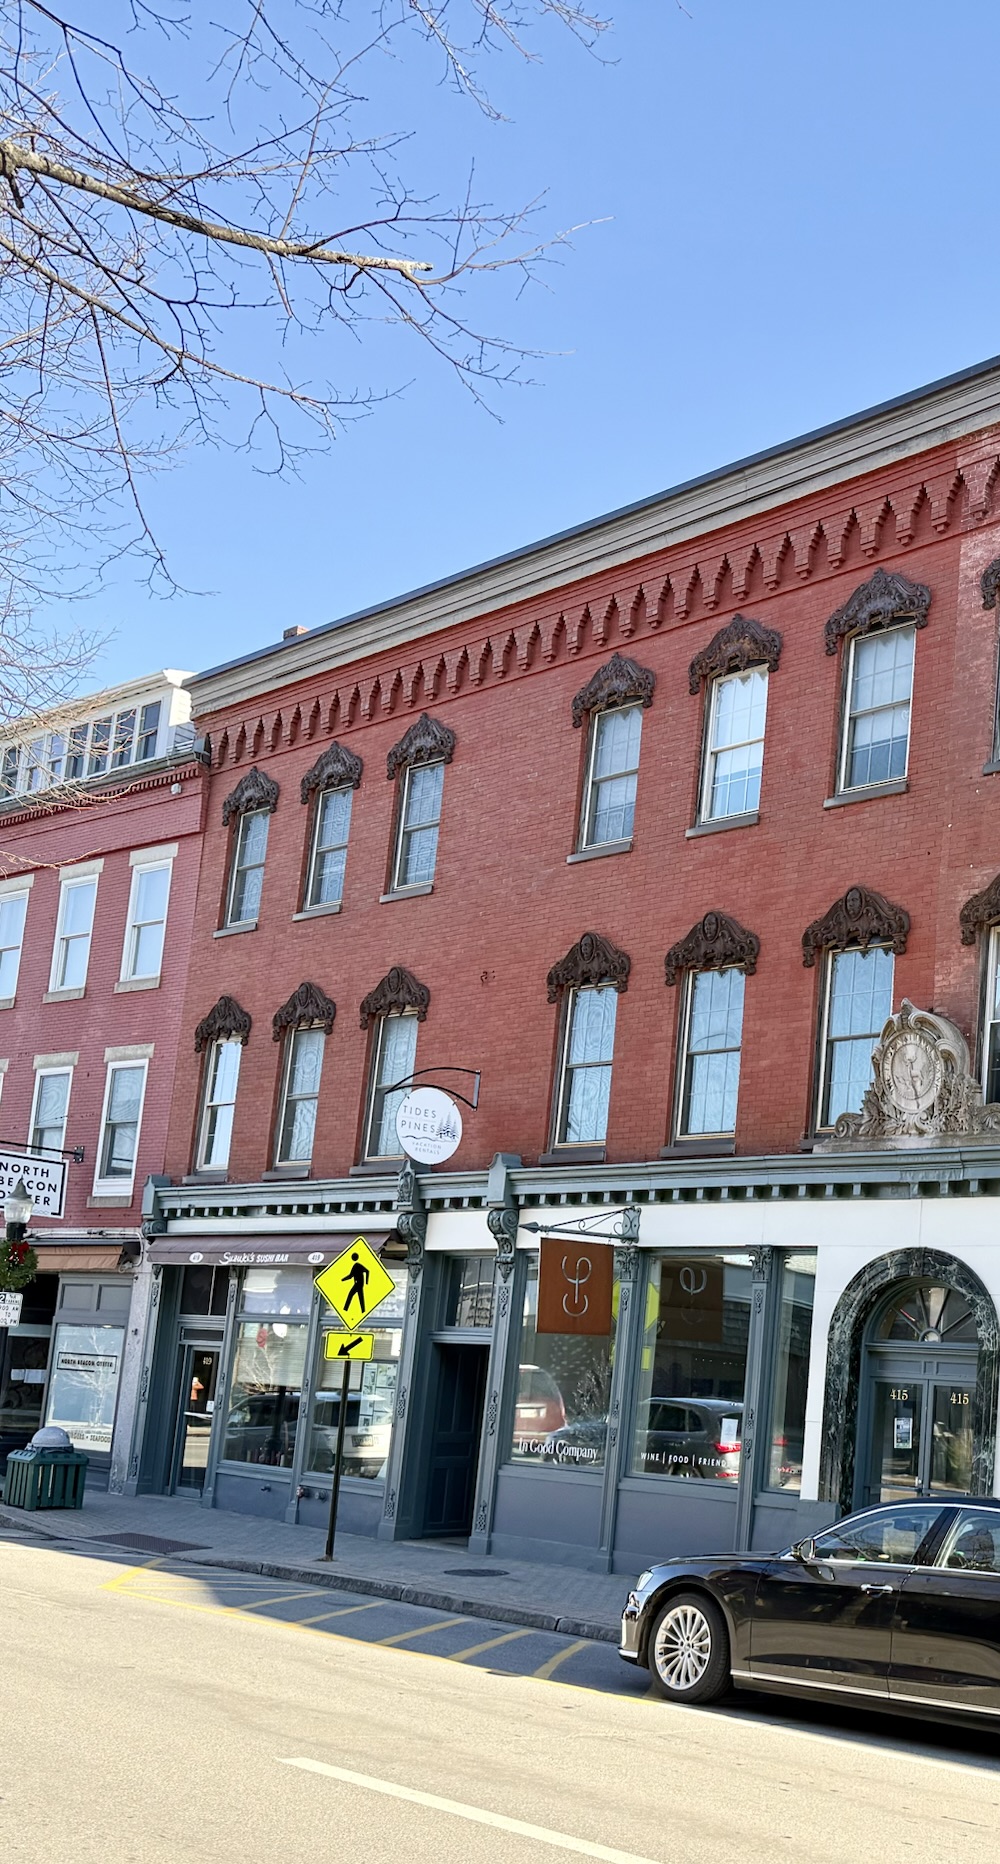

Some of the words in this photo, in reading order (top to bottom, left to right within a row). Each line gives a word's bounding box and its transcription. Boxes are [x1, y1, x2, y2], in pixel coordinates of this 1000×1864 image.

[403, 1105, 437, 1118] TIDES
[401, 1120, 436, 1134] PINES
[412, 1141, 442, 1150] VACATION
[0, 1161, 49, 1178] NORTH
[0, 1176, 57, 1193] BECON
[256, 1254, 275, 1263] SUSHI
[275, 1254, 289, 1262] BAR
[890, 1389, 909, 1401] 415
[950, 1392, 969, 1405] 415
[519, 1437, 528, 1452] In
[530, 1438, 555, 1455] Good
[556, 1440, 598, 1461] Company
[640, 1452, 660, 1461] WINE
[668, 1454, 689, 1464] FOOD
